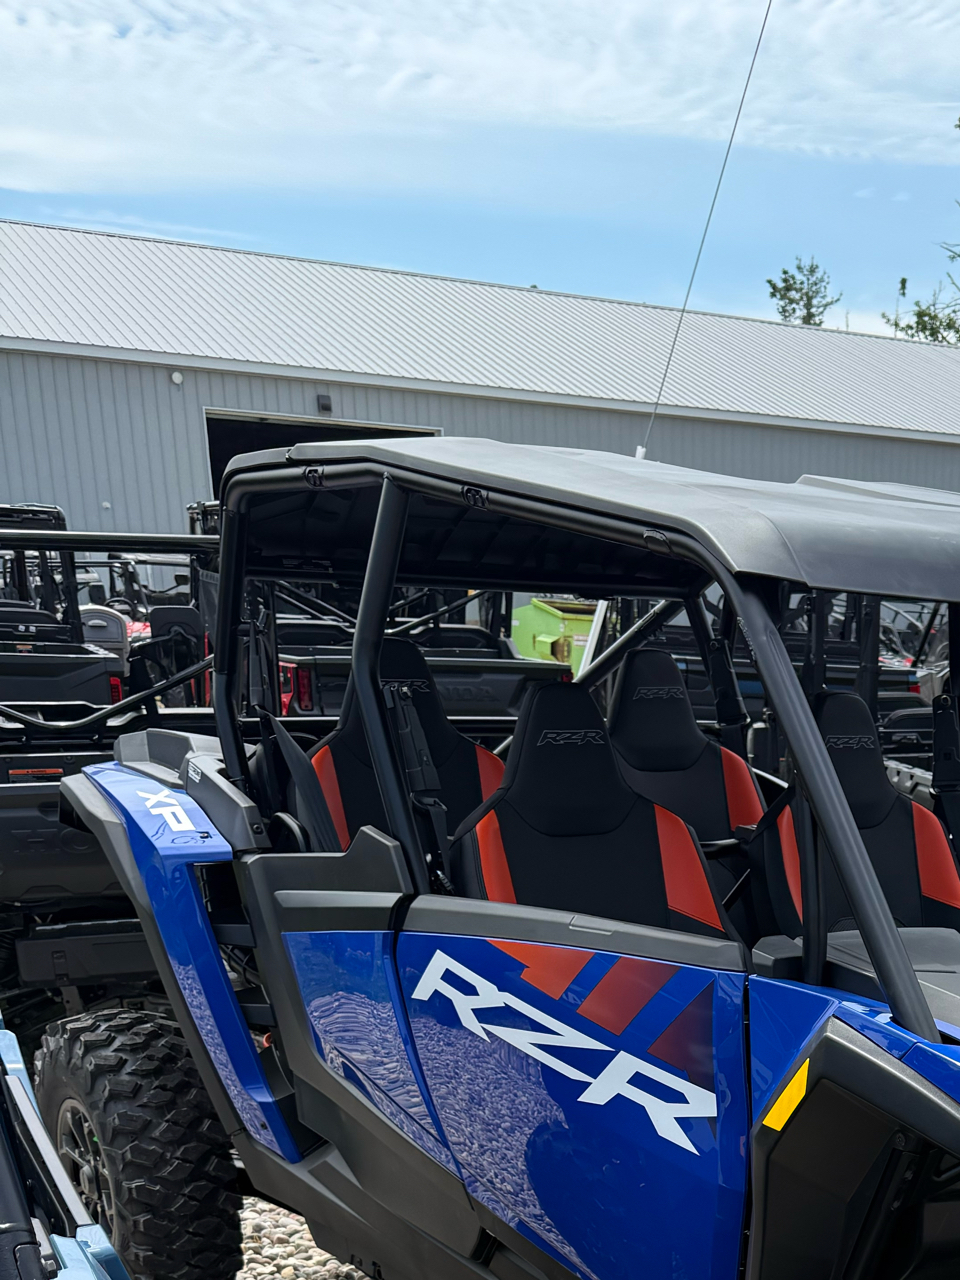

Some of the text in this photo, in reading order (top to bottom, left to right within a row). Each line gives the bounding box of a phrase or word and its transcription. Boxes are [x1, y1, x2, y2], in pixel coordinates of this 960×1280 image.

[633, 686, 684, 699] RZR
[537, 729, 605, 746] RZR
[825, 735, 874, 749] RZR
[136, 789, 196, 832] XP
[411, 949, 718, 1156] RZR
